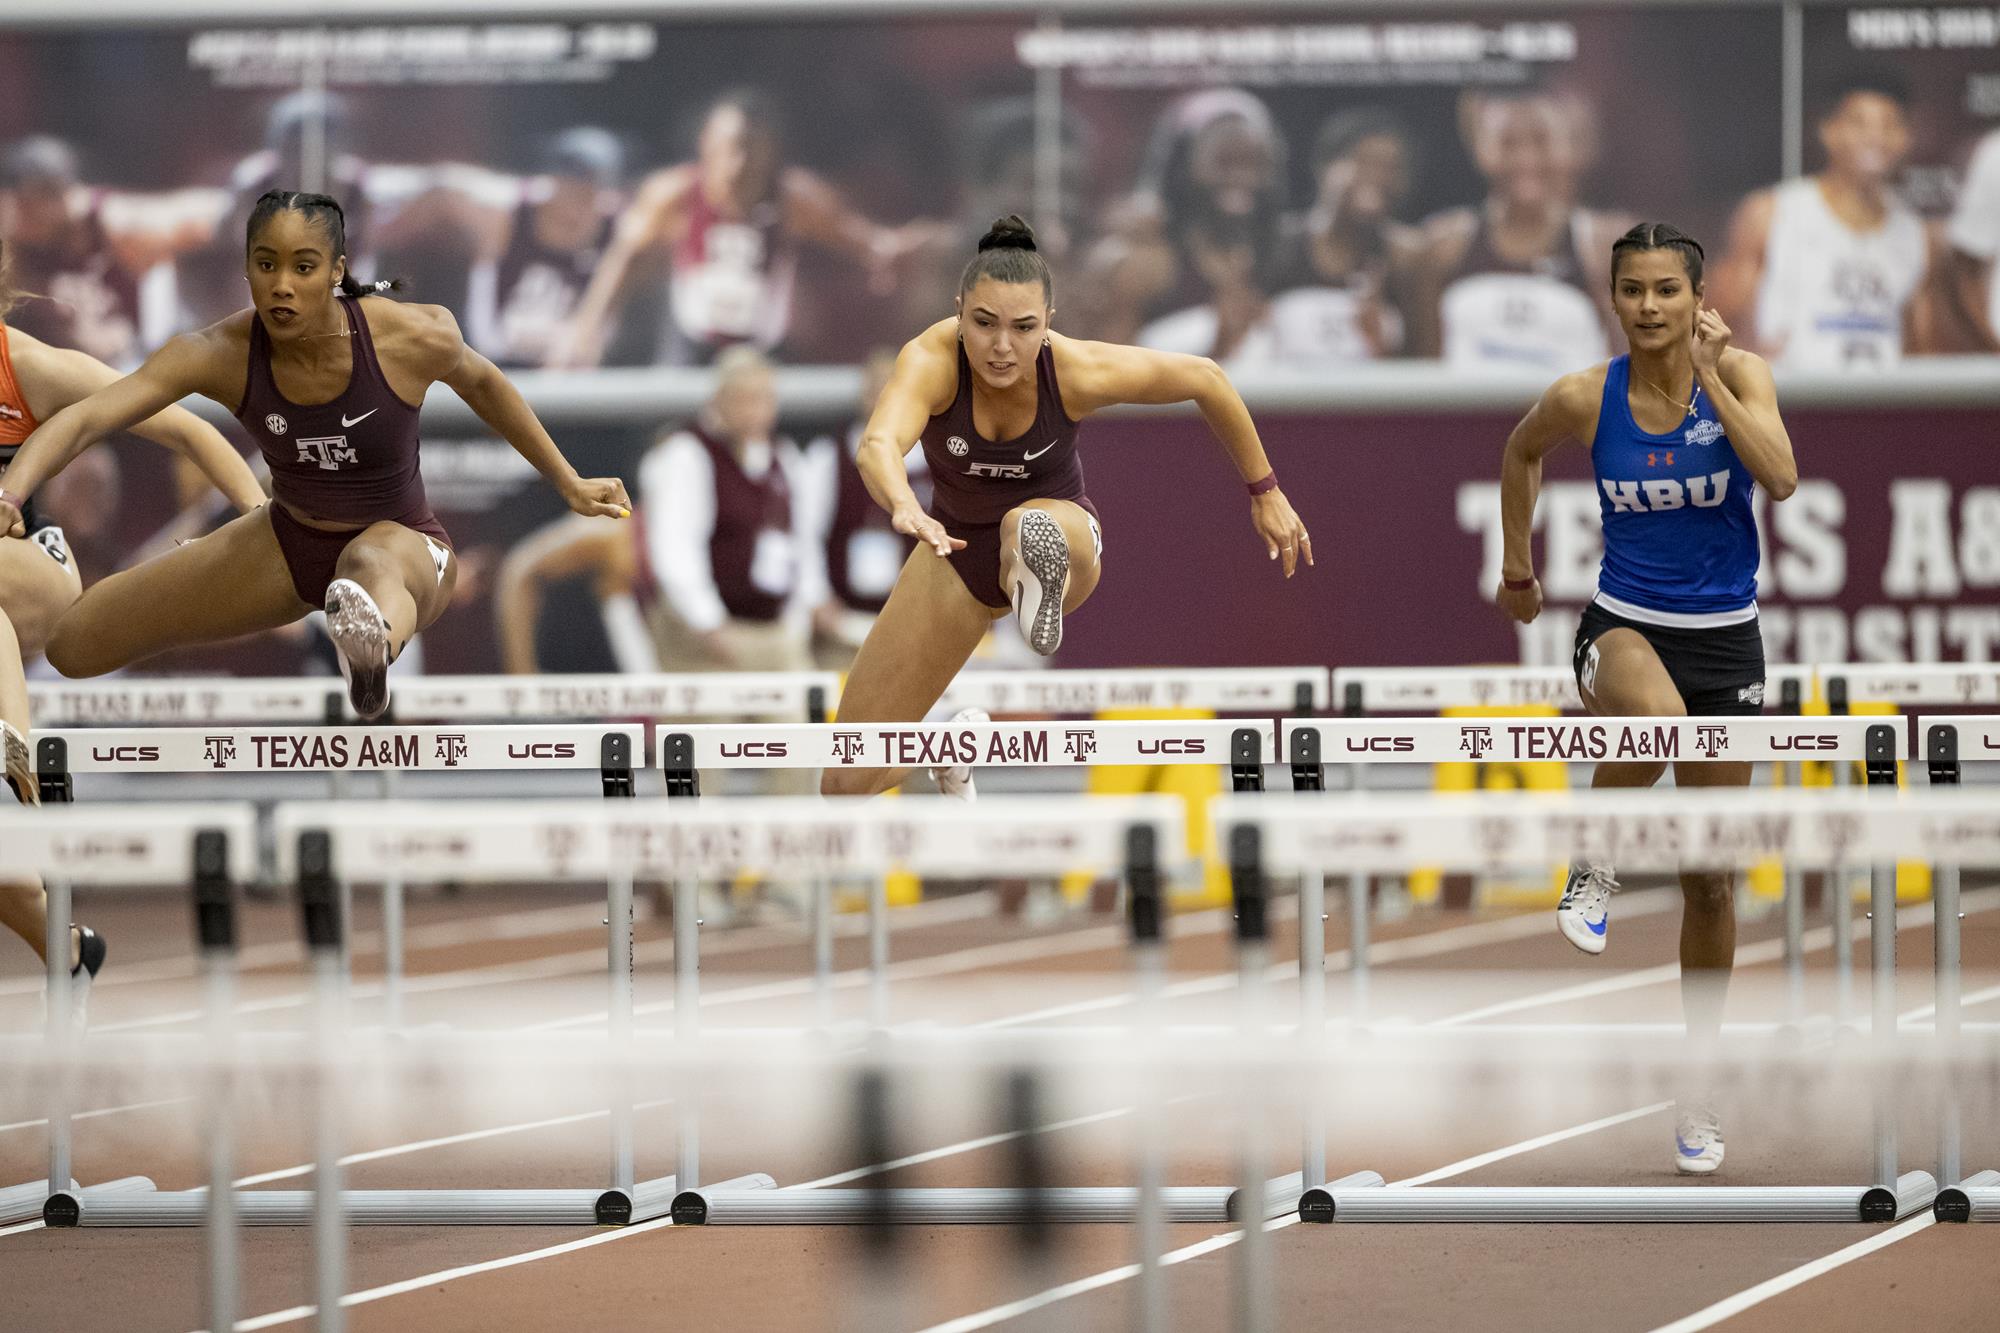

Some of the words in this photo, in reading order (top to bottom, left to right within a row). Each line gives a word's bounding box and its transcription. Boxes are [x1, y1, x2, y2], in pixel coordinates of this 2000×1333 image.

[267, 415, 286, 433] SEC
[1601, 468, 1731, 513] HBU
[1455, 481, 1847, 600] TES
[92, 746, 160, 761] UCS
[251, 734, 349, 768] TEXAS
[357, 734, 419, 768] A&M
[509, 743, 576, 759] UCS
[720, 743, 788, 758] UCS
[879, 730, 977, 764] TEXAS
[985, 730, 1048, 763] A&M
[1138, 739, 1206, 754] UCS
[1347, 738, 1415, 752] UCS
[1508, 726, 1608, 759] TEXAS
[1616, 725, 1679, 759] A&M
[1771, 735, 1839, 750] UCS
